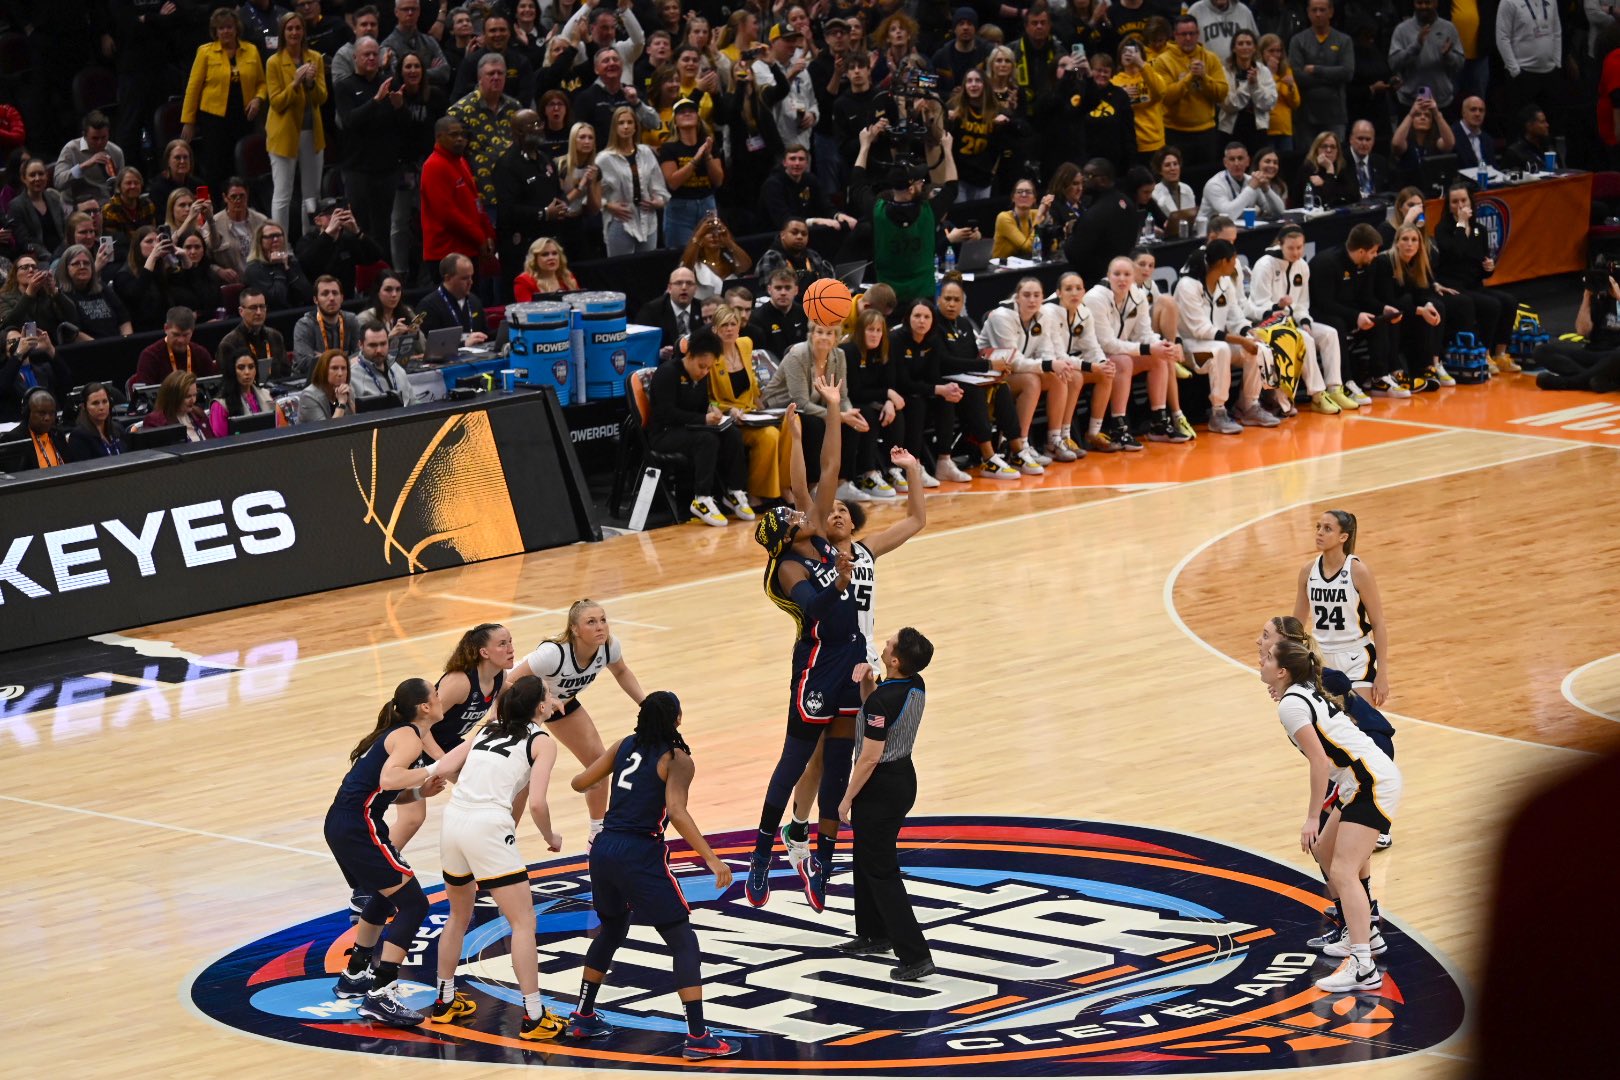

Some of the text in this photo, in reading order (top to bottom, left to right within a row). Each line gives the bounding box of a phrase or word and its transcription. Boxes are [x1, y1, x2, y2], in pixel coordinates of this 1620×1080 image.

[570, 424, 620, 443] OWERADE
[1311, 588, 1347, 602] IOWA
[1315, 605, 1345, 630] 24
[472, 727, 525, 758] 22
[617, 752, 642, 790] 2
[628, 899, 1261, 1043] FOUR
[948, 952, 1318, 1051] CLEVELAND
